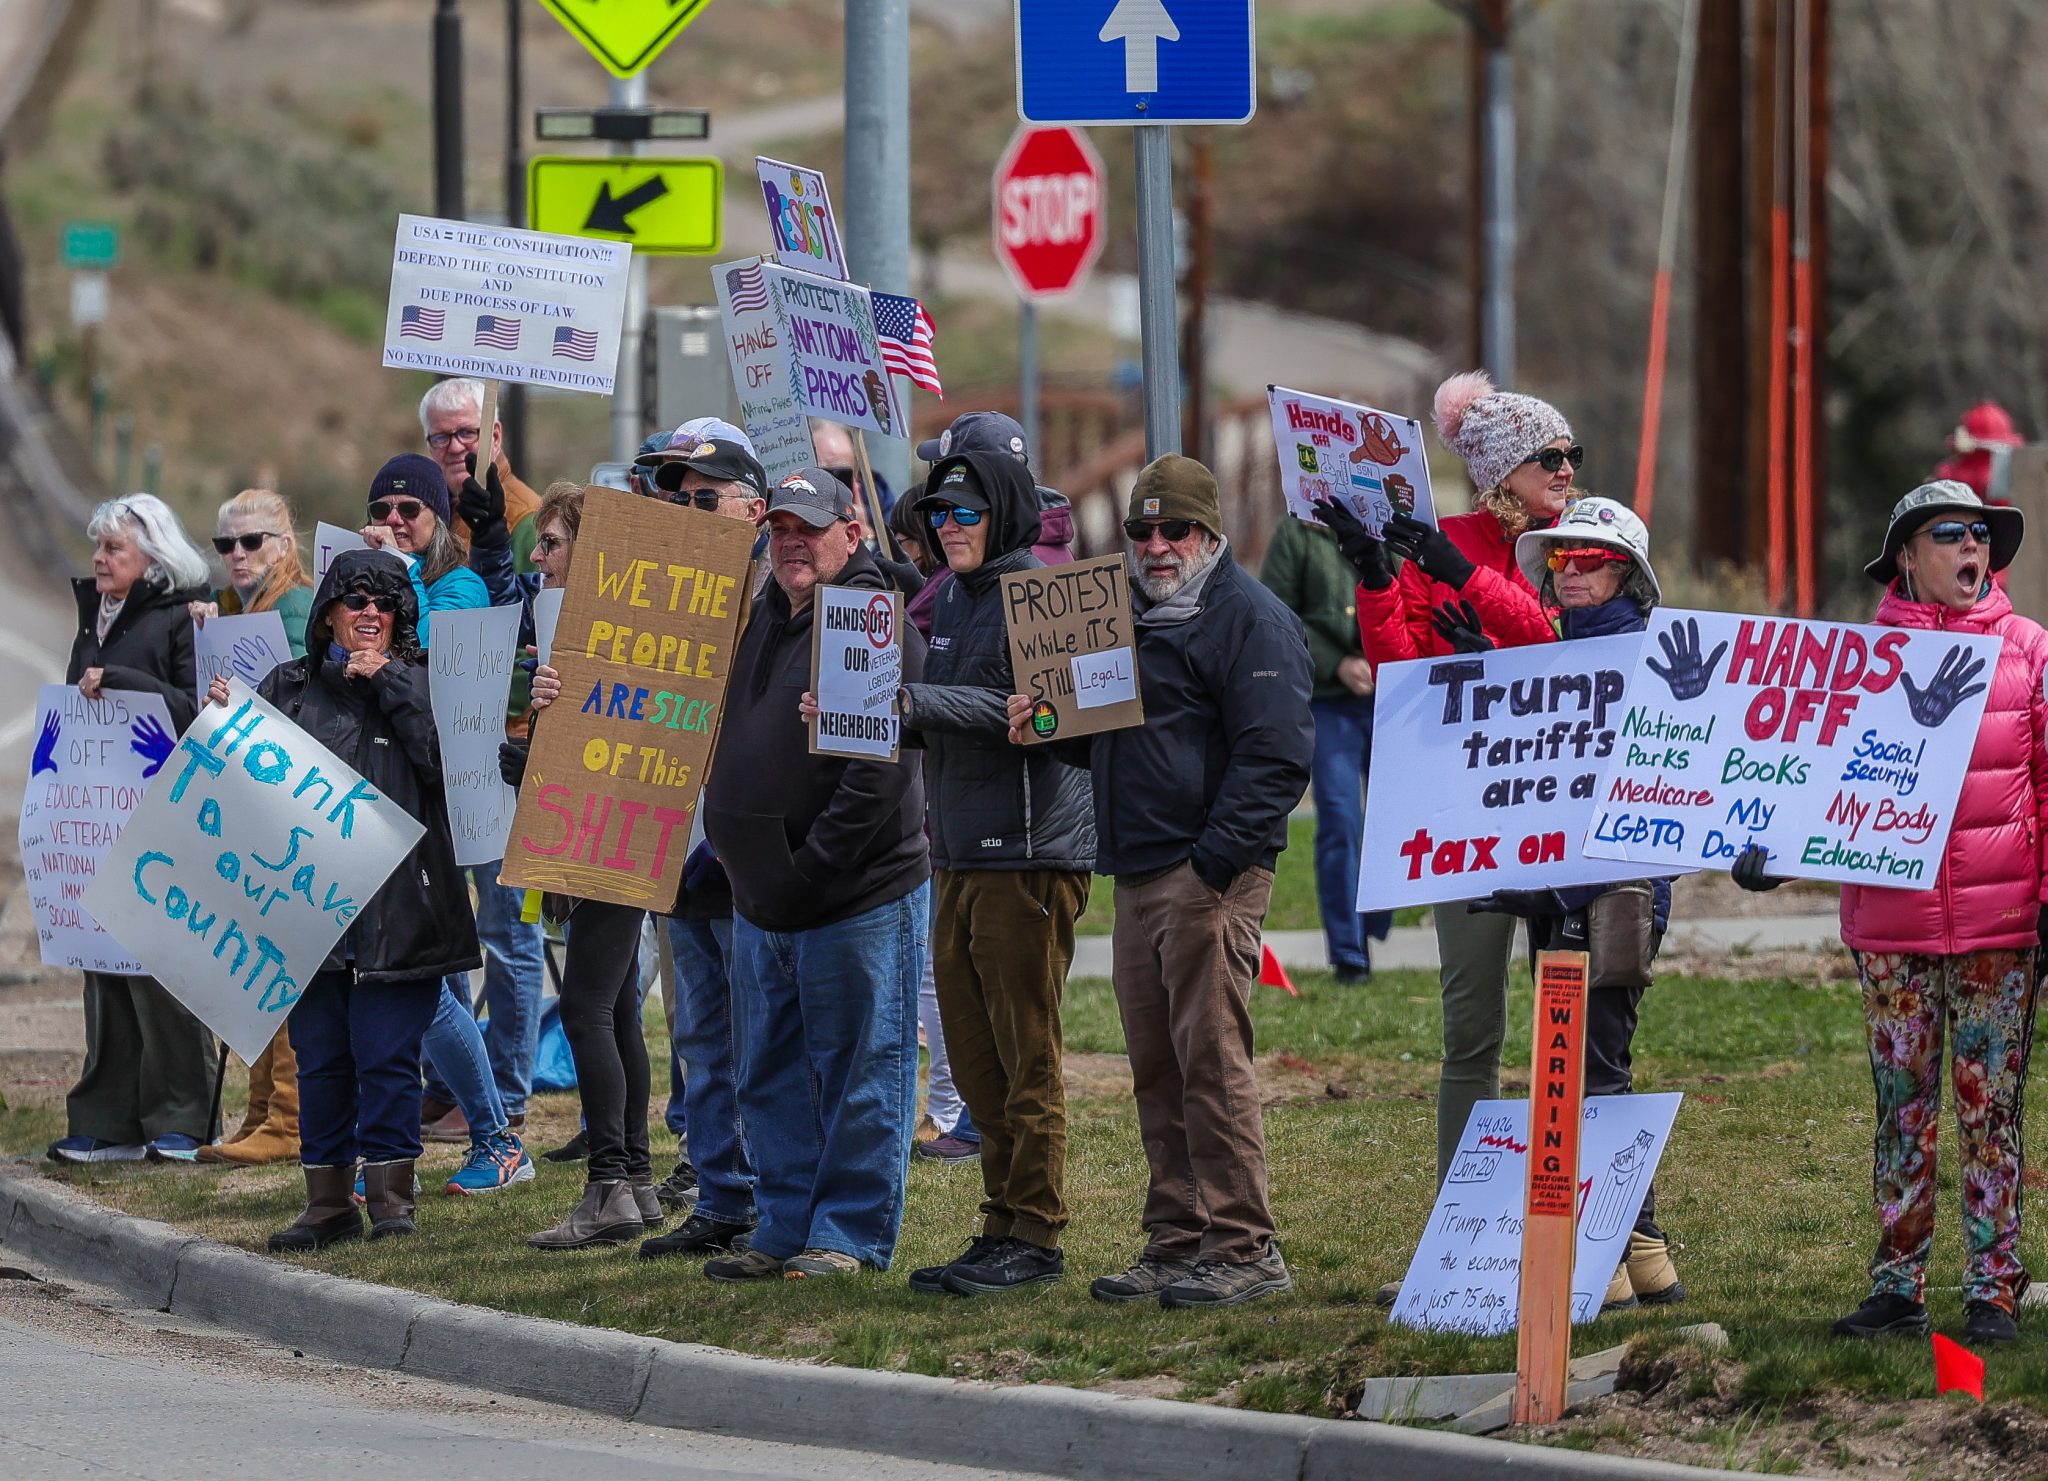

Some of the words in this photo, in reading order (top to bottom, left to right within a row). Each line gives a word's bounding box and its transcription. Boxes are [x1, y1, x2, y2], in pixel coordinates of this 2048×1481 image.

[762, 180, 832, 262] RESIST
[1002, 173, 1093, 246] STOP
[412, 225, 440, 240] USA
[457, 231, 488, 247] THE
[493, 236, 612, 262] CONSTITUTION!!!
[398, 250, 458, 269] DEFEND
[462, 259, 491, 273] THE
[497, 263, 605, 287] CONSTITUTION
[481, 279, 513, 293] AND
[420, 288, 451, 302] DUE
[454, 292, 517, 311] PROCESS
[520, 302, 540, 314] OF
[543, 304, 576, 319] LAW
[780, 277, 840, 313] PROTECT
[790, 314, 871, 365] NATIONAL
[386, 349, 404, 361] NO
[406, 352, 525, 377] EXTRAORDINARY
[529, 369, 613, 389] RENDITION!!
[745, 363, 773, 389] OFF
[804, 366, 868, 417] PARKS
[1286, 404, 1355, 442] Hands
[597, 551, 659, 608] WE
[666, 564, 736, 618] THE
[1008, 563, 1122, 624] PROTEST
[826, 605, 867, 631] HANDS
[869, 610, 890, 634] OFF
[434, 623, 466, 677] We
[585, 620, 717, 678] PEOPLE
[844, 646, 869, 673] OUR
[869, 647, 900, 672] VETERAN
[1725, 619, 1910, 694] HANDS
[64, 695, 130, 725] HANDS
[581, 678, 654, 721] ARE
[648, 690, 716, 735] SICK
[863, 685, 900, 711] IMMIGRANT
[1428, 659, 1624, 729] Trump
[452, 700, 487, 736] Hands
[1621, 706, 1716, 745] National
[1744, 686, 1860, 746] OFF
[69, 738, 115, 767] OFF
[582, 738, 633, 776] OF
[1462, 720, 1617, 769] tariffs
[1852, 729, 1927, 767] Social
[45, 783, 144, 811] EDUCATION
[1482, 774, 1558, 808] are
[1569, 772, 1596, 799] a
[1608, 774, 1714, 807] Medicare
[1594, 812, 1685, 853] LGBTQ
[1725, 797, 1777, 831] My
[1825, 789, 1872, 842] My
[1872, 797, 1939, 844] Body
[1400, 828, 1501, 880] tax
[1518, 831, 1566, 864] on
[1800, 837, 1924, 880] Education
[216, 851, 290, 917] our
[49, 905, 84, 929] SOCIAL
[1544, 1007, 1571, 1173] WARNING
[1454, 1158, 1477, 1178] Jan
[1476, 1157, 1495, 1176] 20
[1531, 1182, 1570, 1191] DIGGING
[1533, 1174, 1570, 1183] BEFORE
[1539, 1190, 1562, 1199] CALL
[1439, 1202, 1487, 1245] Trump
[1497, 1210, 1525, 1235] tras
[1440, 1251, 1456, 1270] the
[1408, 1288, 1420, 1309] in
[1424, 1290, 1458, 1317] just
[1461, 1288, 1484, 1308] 75
[1480, 1289, 1505, 1315] days
